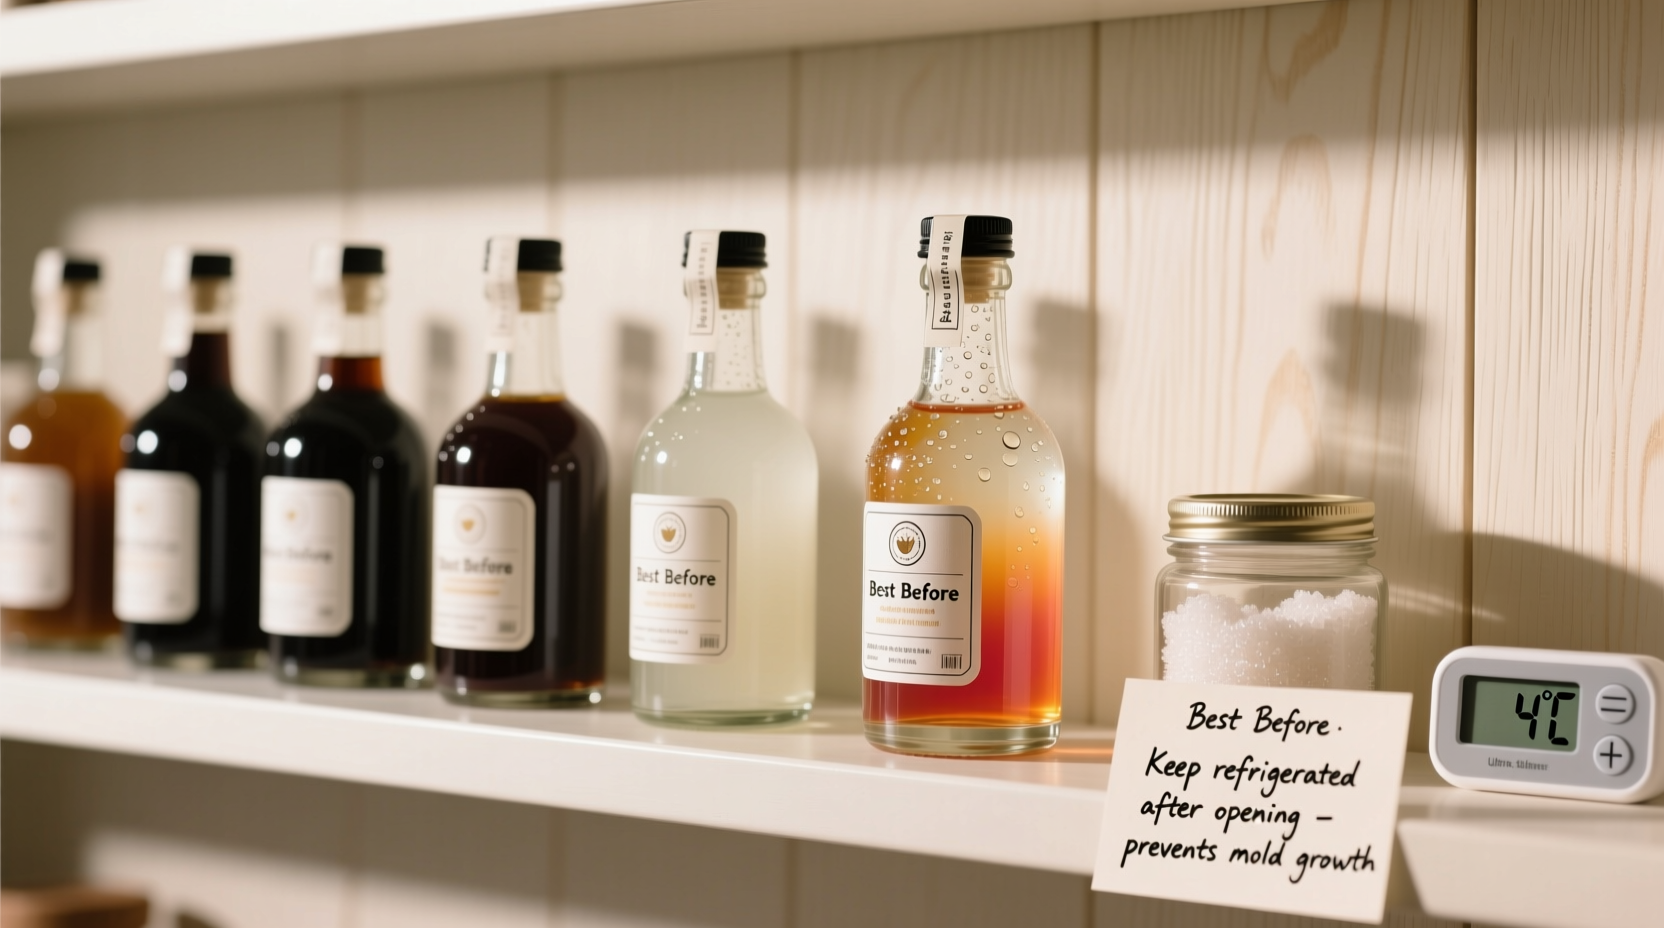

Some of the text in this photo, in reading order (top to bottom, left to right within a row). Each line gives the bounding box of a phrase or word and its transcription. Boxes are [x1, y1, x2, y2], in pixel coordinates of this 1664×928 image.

[636, 567, 717, 587] Best Before
[869, 580, 960, 601] Best Before
[1186, 701, 1242, 731] Best
[1145, 746, 1361, 798] Keep refrigerated
[1140, 791, 1203, 825] after
[1214, 803, 1301, 841] opening
[1120, 838, 1375, 884] prevents mold growth
